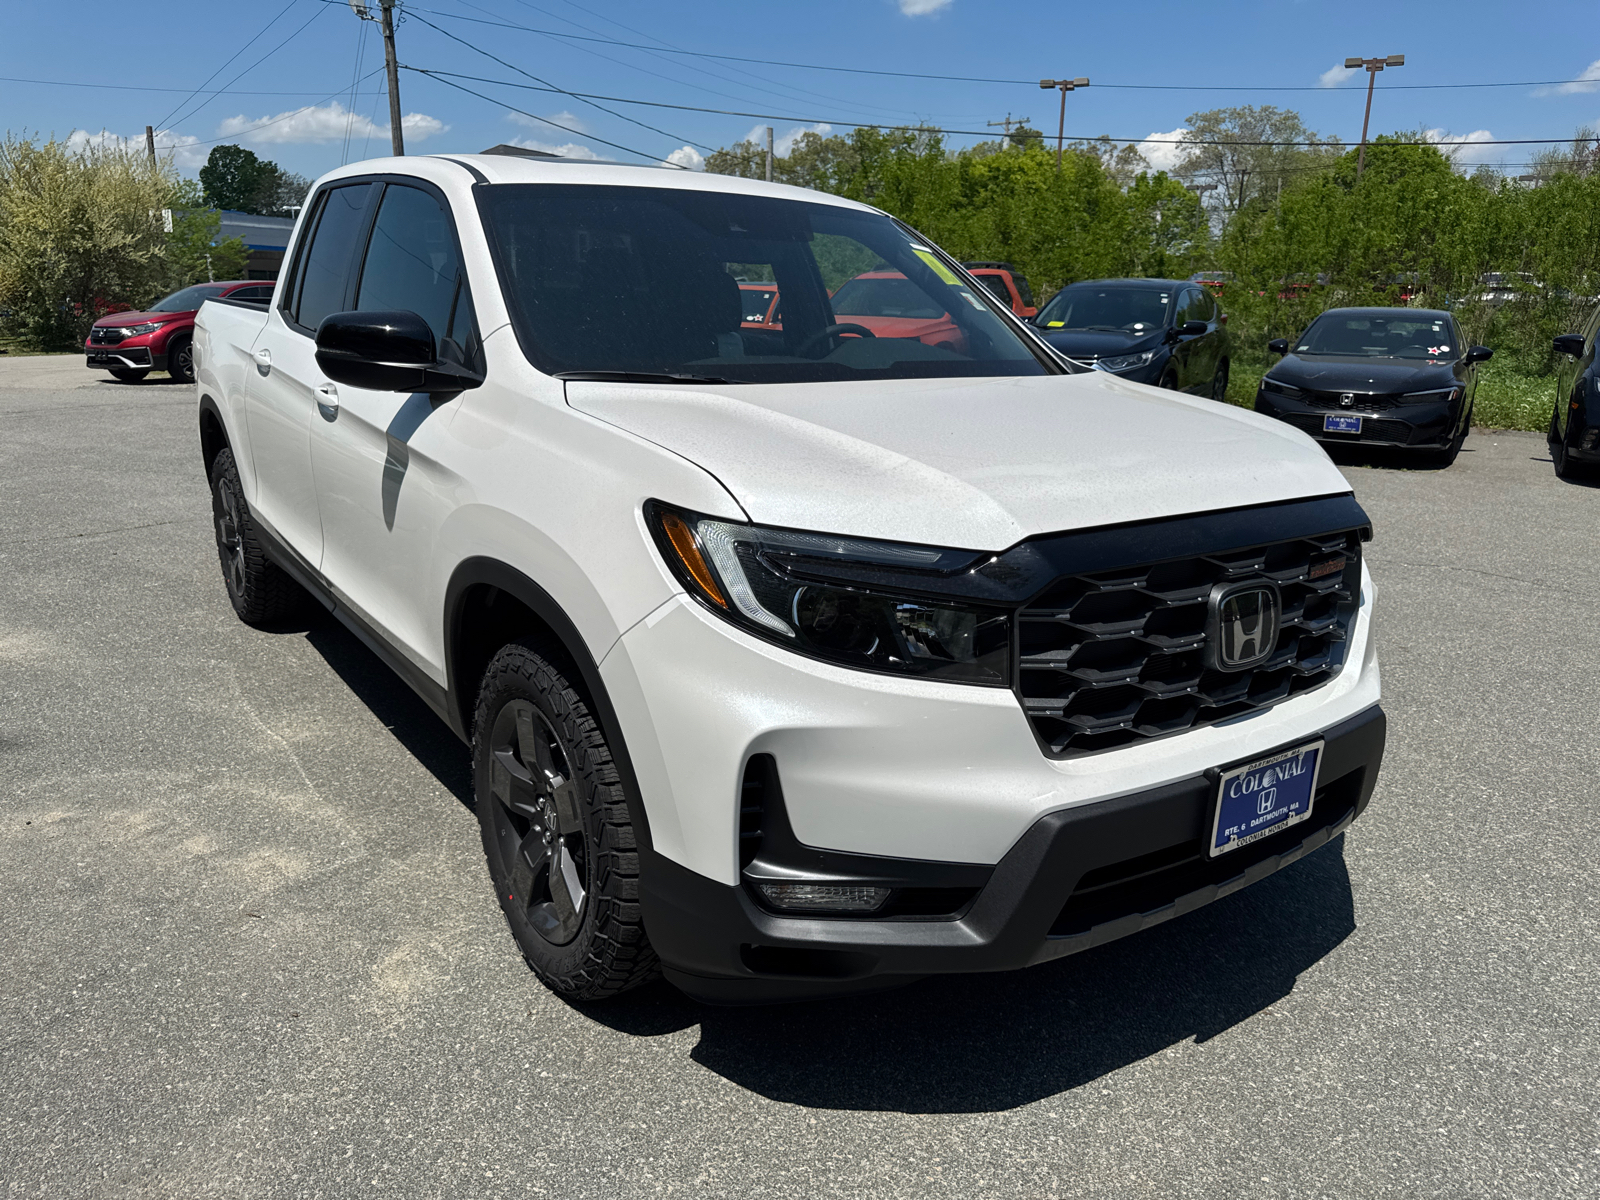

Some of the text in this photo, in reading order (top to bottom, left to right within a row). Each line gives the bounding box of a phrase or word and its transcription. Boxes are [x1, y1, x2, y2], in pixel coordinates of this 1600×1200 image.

[1230, 760, 1306, 798] COLONIAL
[1224, 801, 1299, 837] RTE. 6 DARTMOUTH, MA
[1236, 821, 1289, 847] COLONIAL HONDA
